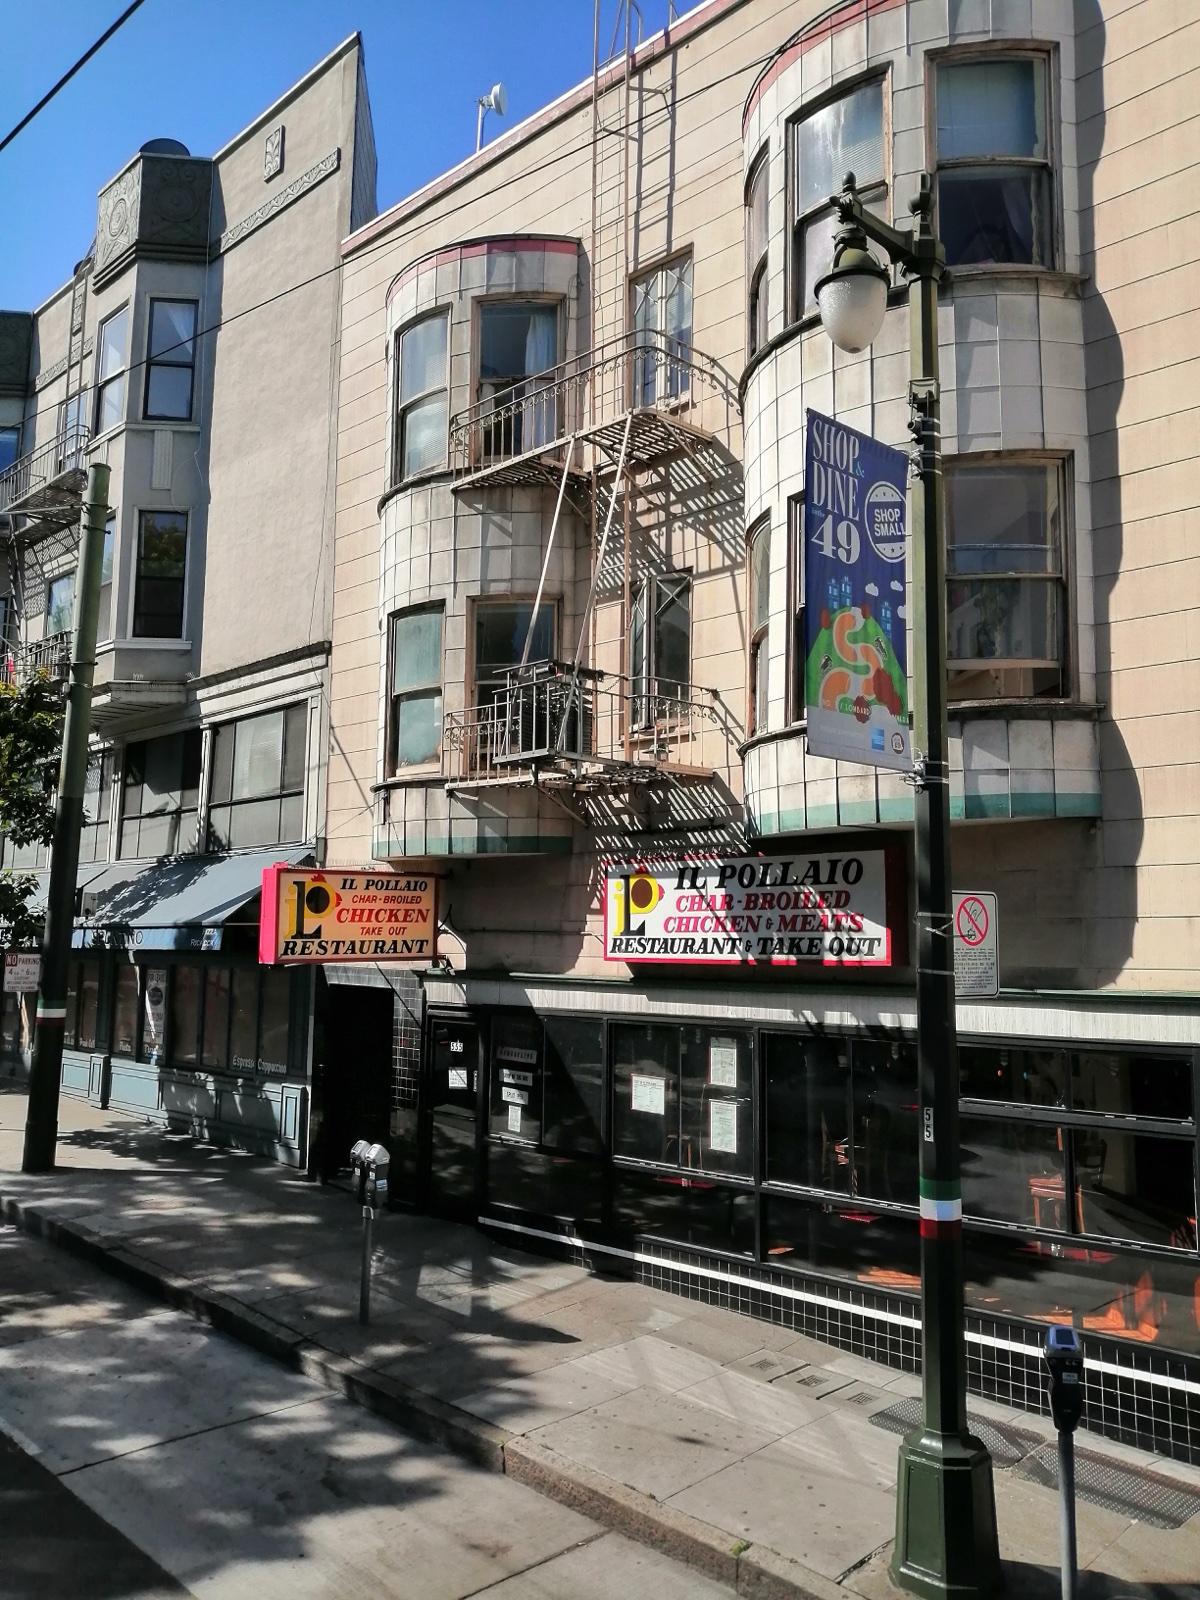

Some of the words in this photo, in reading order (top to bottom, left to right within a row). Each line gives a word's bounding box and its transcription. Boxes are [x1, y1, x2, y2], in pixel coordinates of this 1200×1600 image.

[813, 419, 859, 475] SHOP
[812, 460, 859, 521] DINE
[874, 508, 901, 522] SHOP
[874, 522, 906, 537] SMALL
[811, 514, 860, 565] 49
[674, 865, 708, 890] IL
[715, 858, 863, 889] POLLAIO
[340, 878, 358, 890] IL
[364, 878, 428, 892] POLLAIO
[336, 907, 431, 924] CHICKEN
[663, 915, 762, 933] CHICKEN
[765, 918, 775, 931] &
[777, 912, 865, 933] MEATS
[360, 926, 383, 936] TAKE
[388, 926, 407, 936] OUT
[280, 939, 429, 957] RESTAURANT
[609, 936, 742, 955] RESTAURANT
[744, 939, 753, 952] &
[757, 936, 823, 956] TAKE
[828, 936, 882, 957] OUT
[6, 955, 17, 966] NO
[18, 957, 40, 965] PARKING
[451, 1042, 463, 1052] 555
